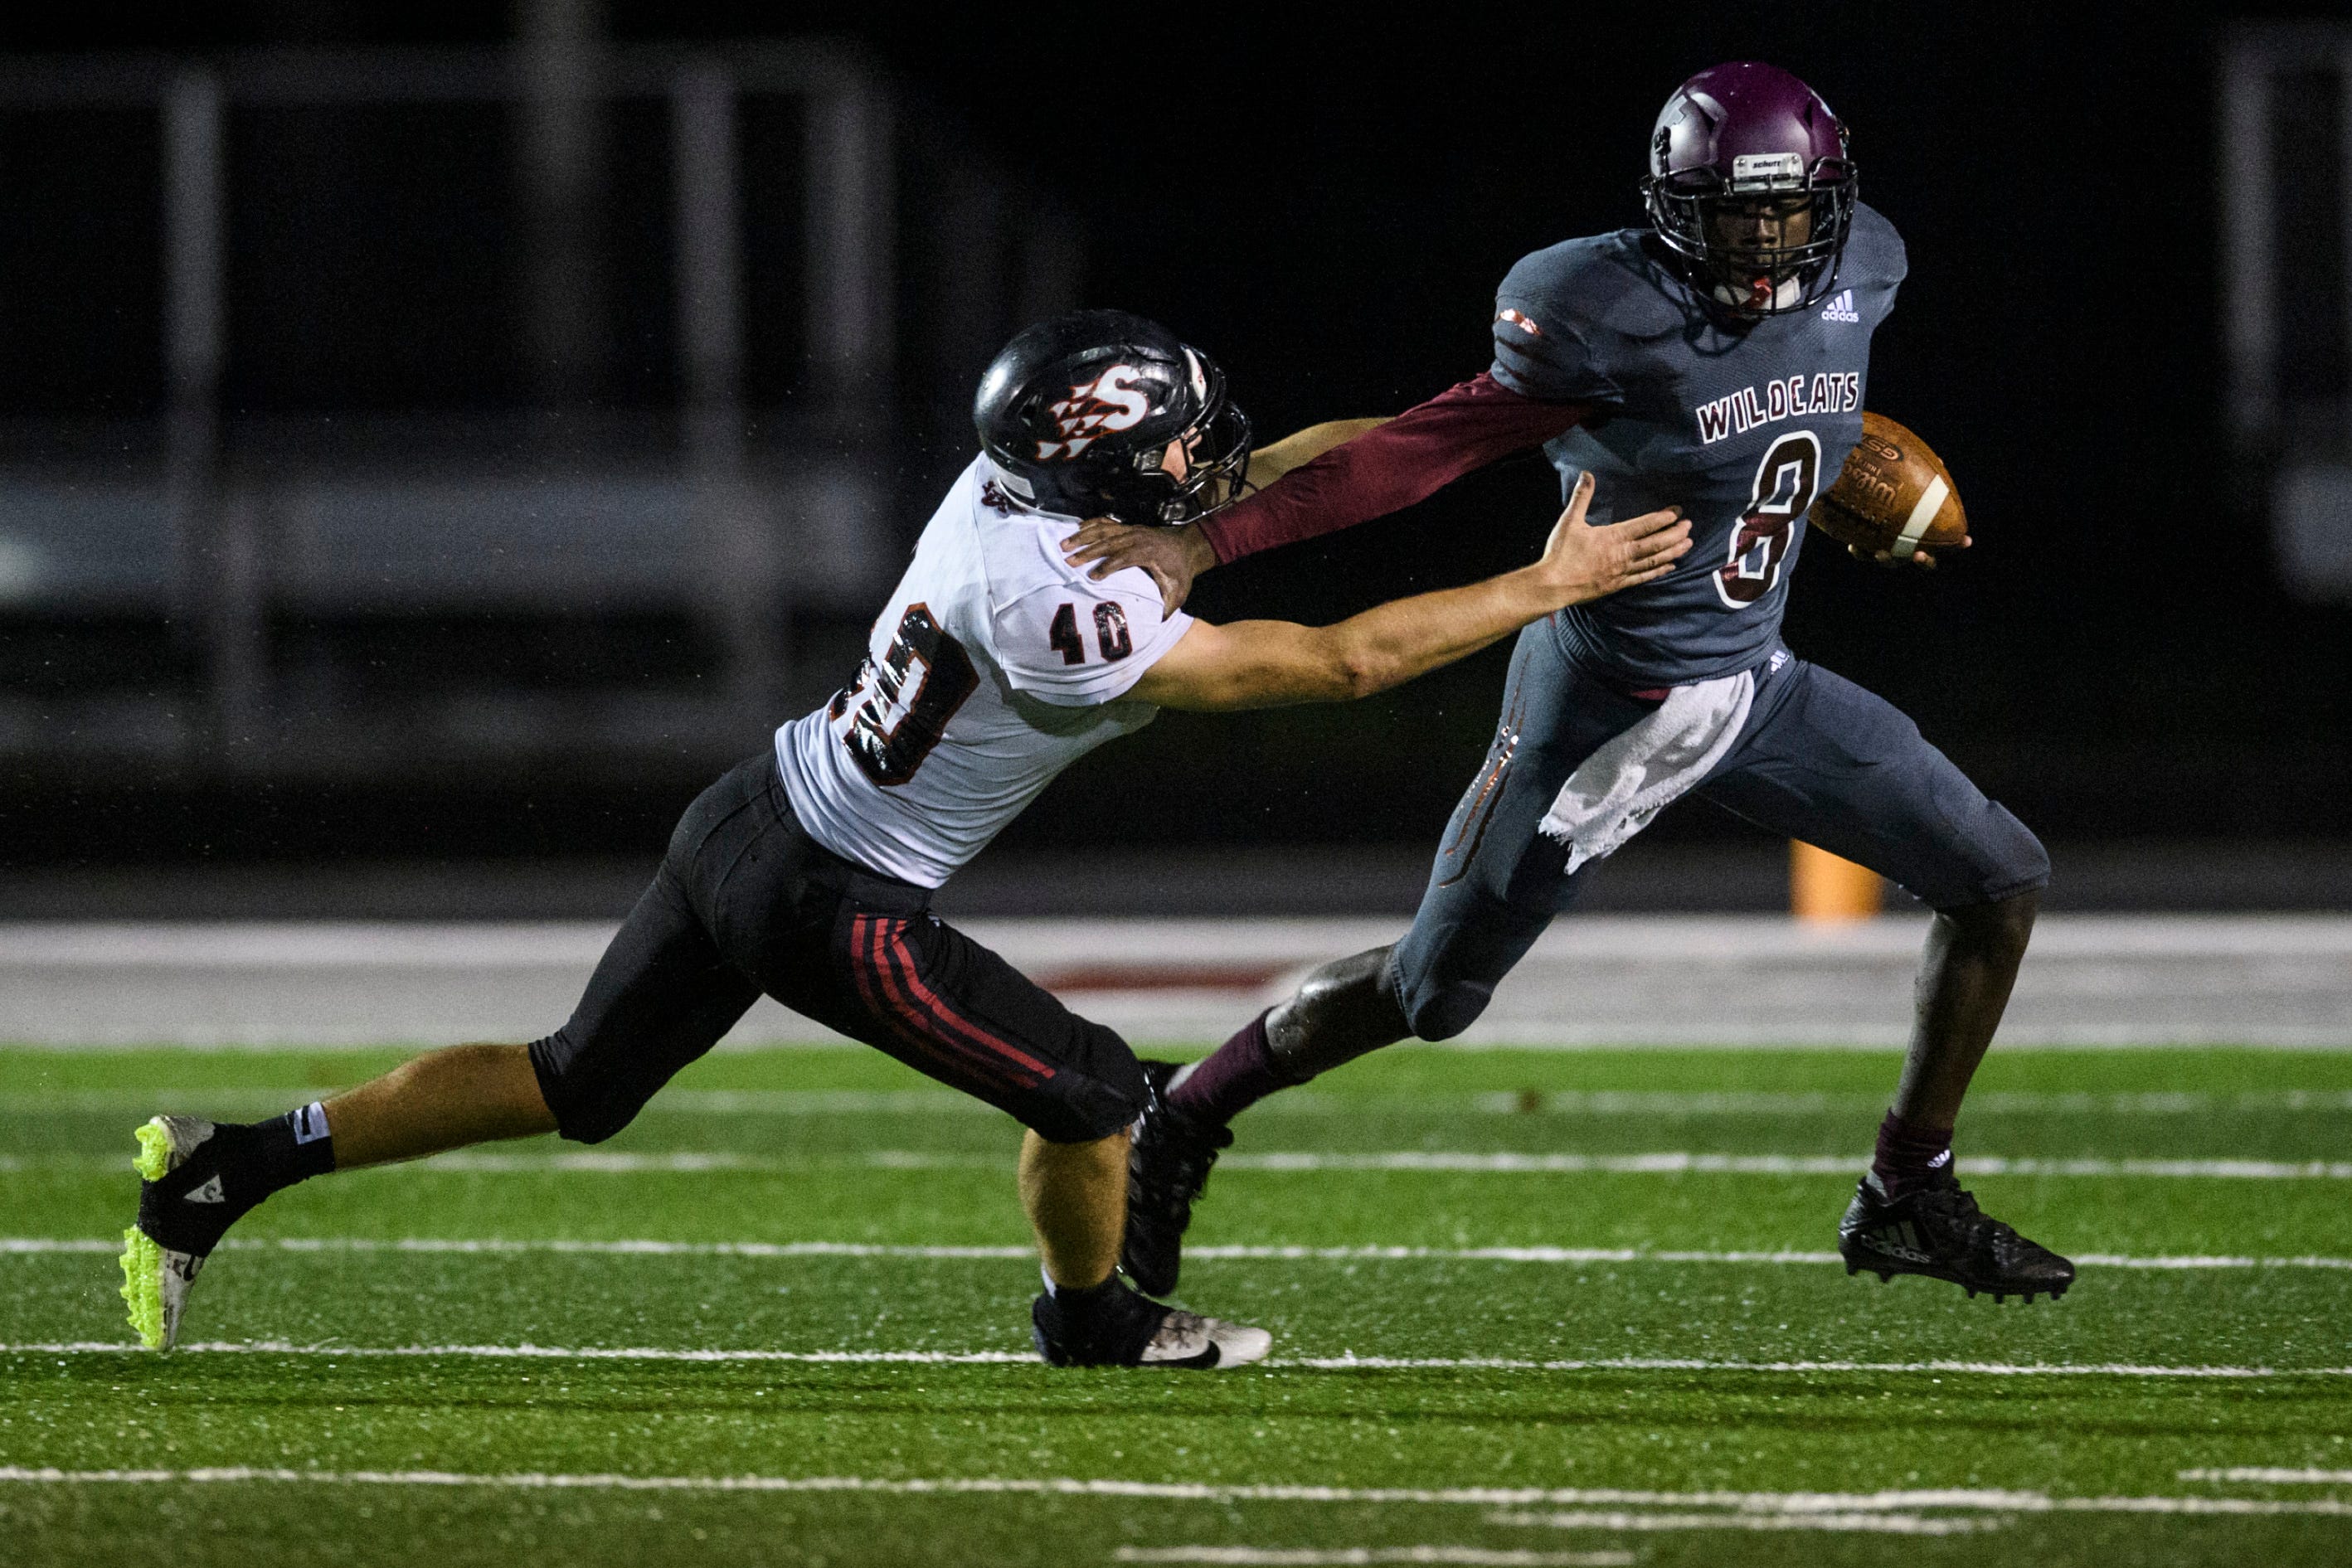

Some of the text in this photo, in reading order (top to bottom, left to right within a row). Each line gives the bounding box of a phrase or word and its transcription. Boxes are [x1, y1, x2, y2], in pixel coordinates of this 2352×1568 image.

[1821, 309, 1859, 323] adidas
[1696, 371, 1859, 444] WILDCATS
[1862, 435, 1899, 461] GS
[1713, 430, 1822, 609] 8
[1049, 600, 1133, 666] 40
